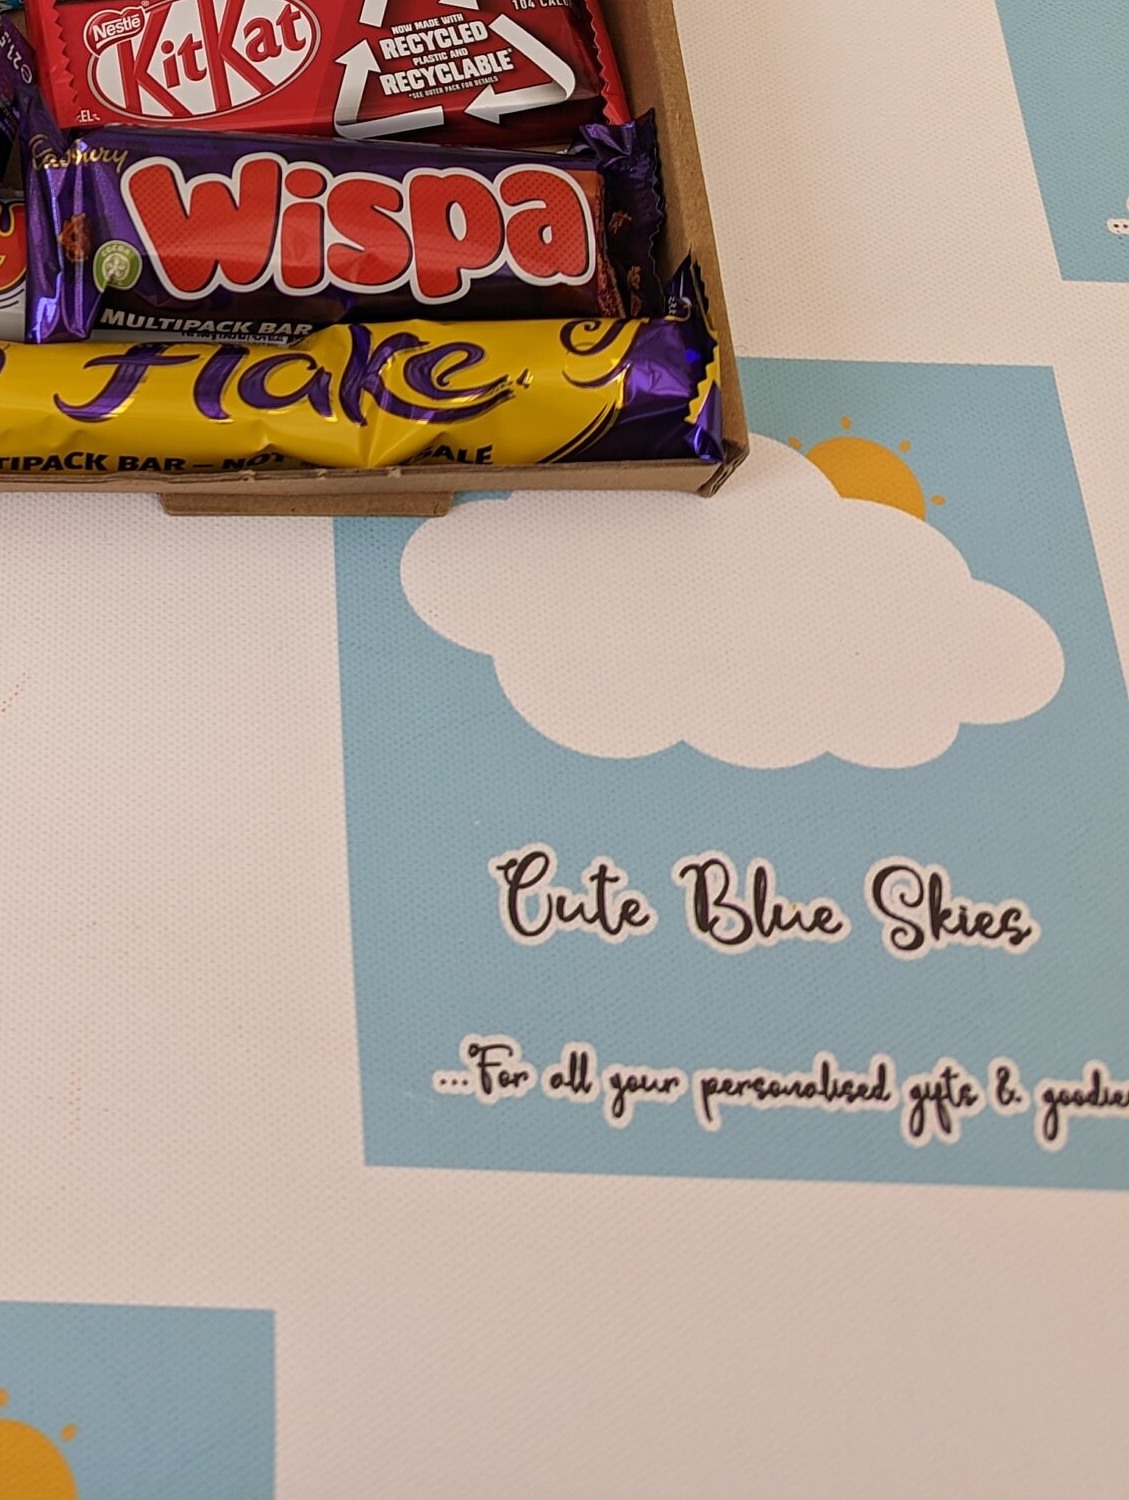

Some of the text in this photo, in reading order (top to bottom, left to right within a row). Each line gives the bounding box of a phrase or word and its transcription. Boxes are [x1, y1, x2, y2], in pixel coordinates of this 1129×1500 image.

[512, 0, 536, 11] 104
[391, 13, 464, 36] NOW MADE WITH
[379, 21, 489, 60] RECYCLED
[412, 47, 469, 67] PLASTIC AND
[424, 86, 444, 97] OUTER
[445, 83, 462, 93] PACK
[462, 80, 475, 90] FOR
[474, 75, 499, 87] DETAILS
[121, 152, 596, 305] Wispa
[100, 308, 313, 336] MULTIPACK BAR
[117, 455, 187, 472] BAR
[497, 850, 1033, 952] Cute Blue Skies
[550, 1051, 593, 1094] all
[609, 1072, 680, 1118] your
[700, 1060, 892, 1123] personalised
[909, 1066, 979, 1138] gifts
[996, 1066, 1022, 1106] &
[1042, 1068, 1129, 1141] goodie
